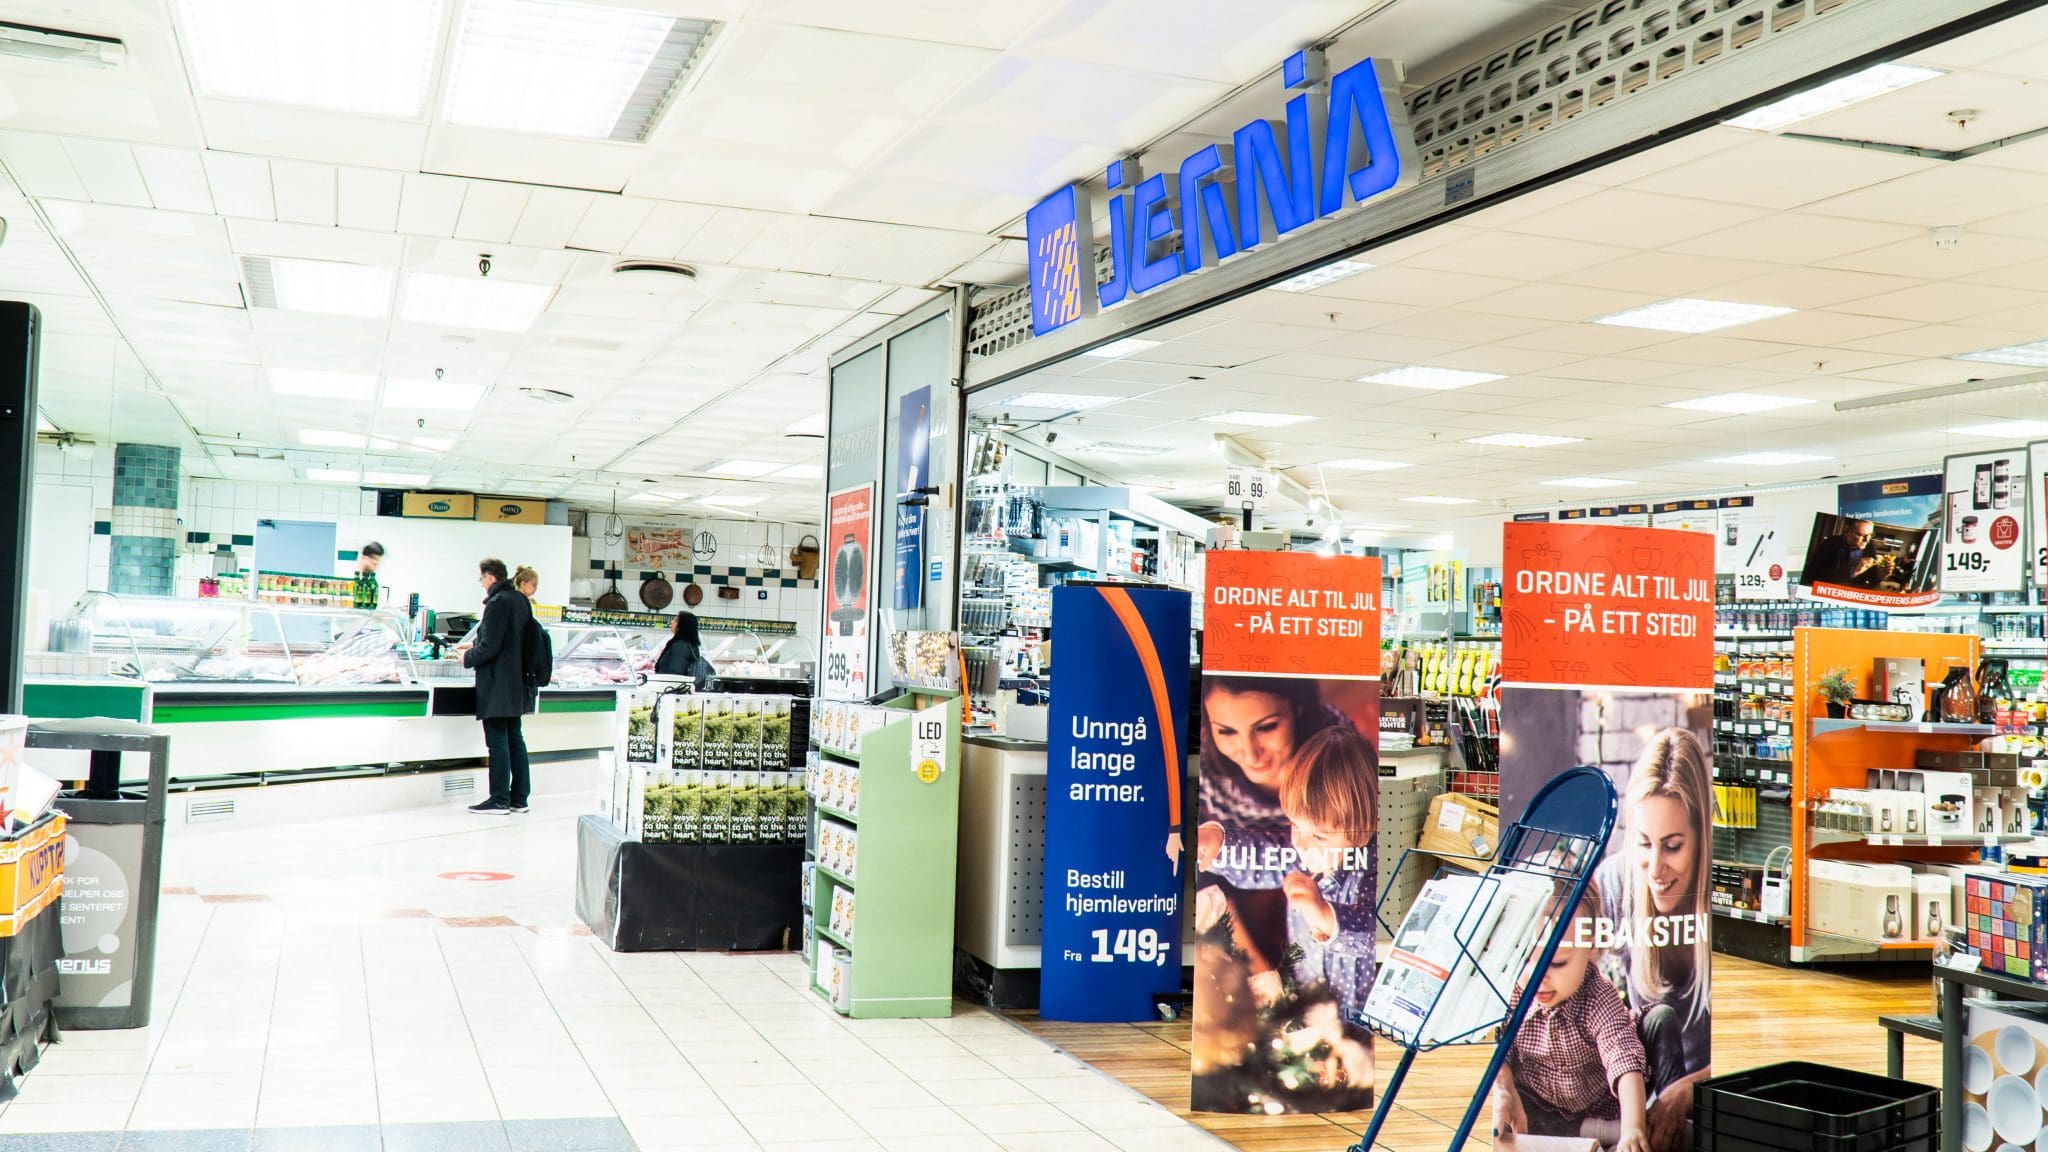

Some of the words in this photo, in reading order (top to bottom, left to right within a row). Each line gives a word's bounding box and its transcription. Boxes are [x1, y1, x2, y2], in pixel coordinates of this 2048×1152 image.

[1516, 570, 1605, 597] ORDNE
[1611, 575, 1648, 599] ALT
[1652, 576, 1680, 600] TIL
[1683, 579, 1710, 603] JUL
[1214, 586, 1283, 607] ORDNE
[1287, 589, 1319, 608] ALT
[1323, 590, 1347, 609] TIL
[1350, 592, 1377, 611] JUL
[1250, 611, 1274, 634] PÅ
[1280, 616, 1313, 636] ETT
[1317, 618, 1363, 637] STED!
[1564, 604, 1595, 633] PÅ
[1602, 611, 1641, 635] ETT
[1646, 613, 1697, 637] STED!
[919, 721, 942, 740] LED
[1071, 716, 1147, 746] Unngå
[674, 749, 684, 757] to
[685, 749, 698, 757] the
[674, 757, 695, 765] heart
[734, 750, 743, 758] to
[744, 750, 757, 758] the
[763, 759, 783, 767] heart
[1071, 747, 1135, 776] lange
[1069, 782, 1145, 803] armer.
[759, 831, 781, 839] heart
[1211, 846, 1369, 872] JULEPYNTEN
[77, 876, 99, 885] FOR
[1067, 869, 1124, 889] Bestill
[62, 889, 100, 898] JELPER
[103, 889, 124, 898] OSS
[69, 902, 121, 912] SENTERET
[1066, 893, 1177, 916] hjemlevering!
[61, 916, 86, 925] ENT!
[1530, 913, 1708, 949] JEBAKSTEN
[1064, 949, 1082, 962] Fra
[1091, 928, 1170, 967] 149,-
